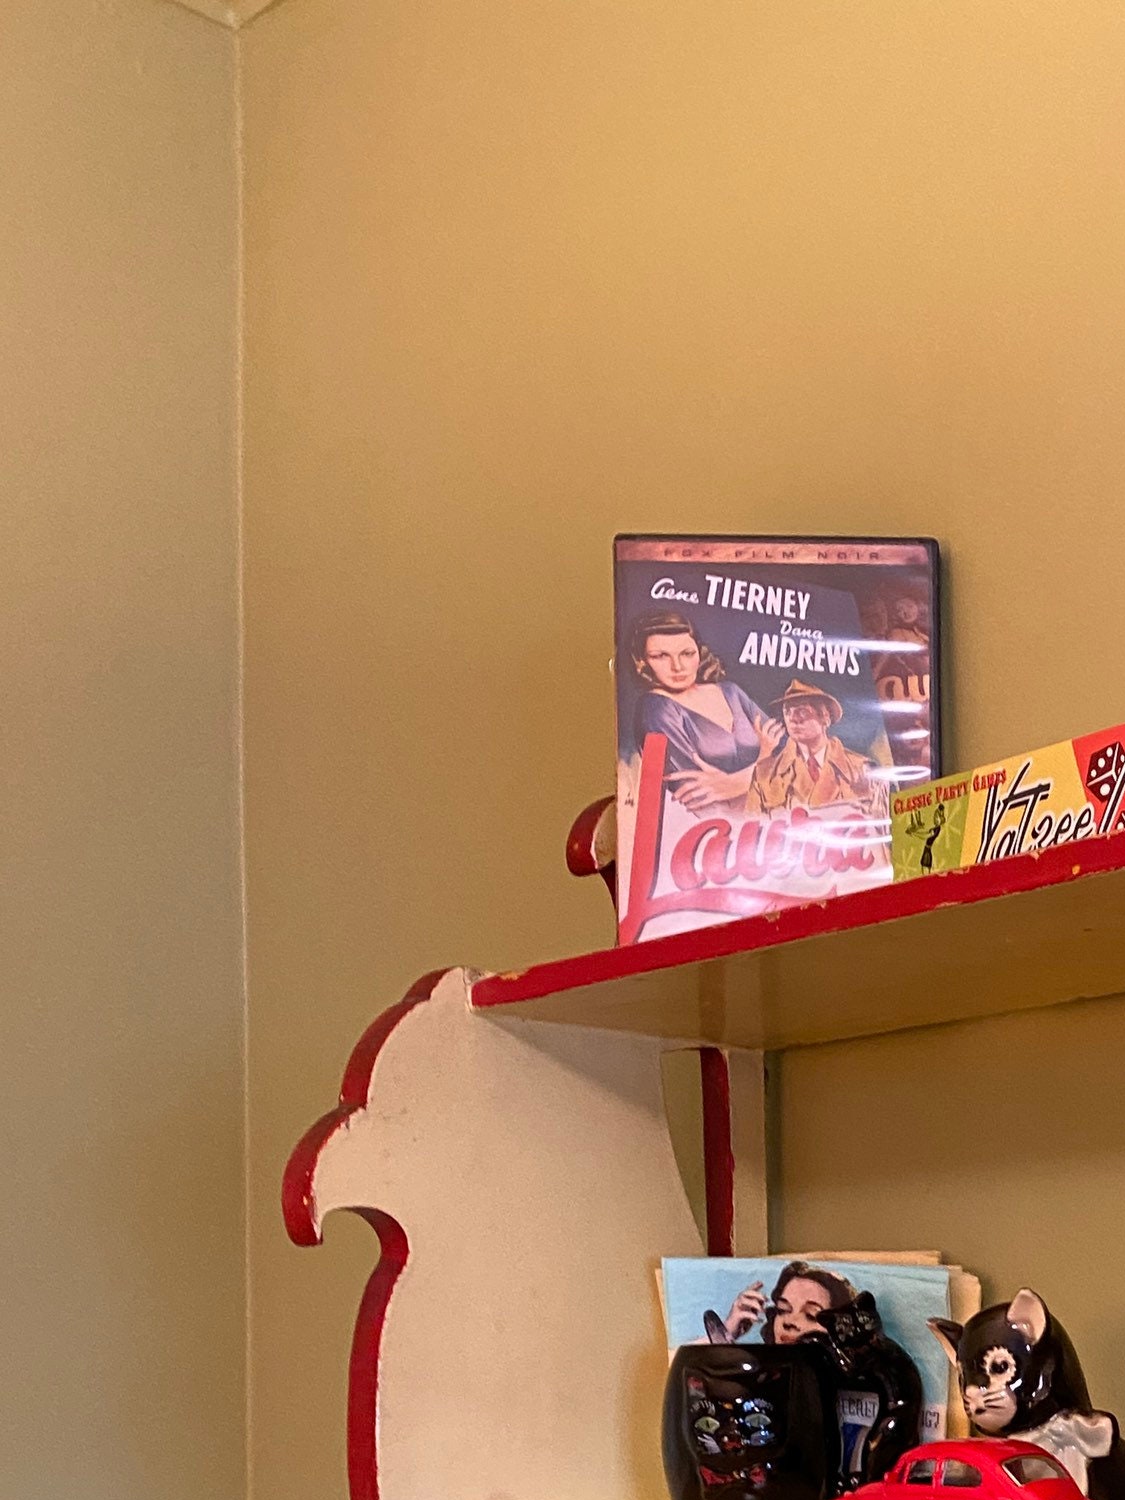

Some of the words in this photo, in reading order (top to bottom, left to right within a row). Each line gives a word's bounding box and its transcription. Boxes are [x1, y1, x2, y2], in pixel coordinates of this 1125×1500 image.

[664, 549, 711, 557] FOX
[734, 551, 795, 559] FILM
[817, 551, 880, 560] NOIR
[650, 577, 700, 604] Gene
[705, 574, 811, 620] TIERNEY
[779, 619, 824, 640] Dana
[738, 631, 860, 676] ANDREWS
[893, 791, 933, 815] CLASSIC
[935, 780, 968, 804] PARTY
[618, 732, 875, 946] Laura
